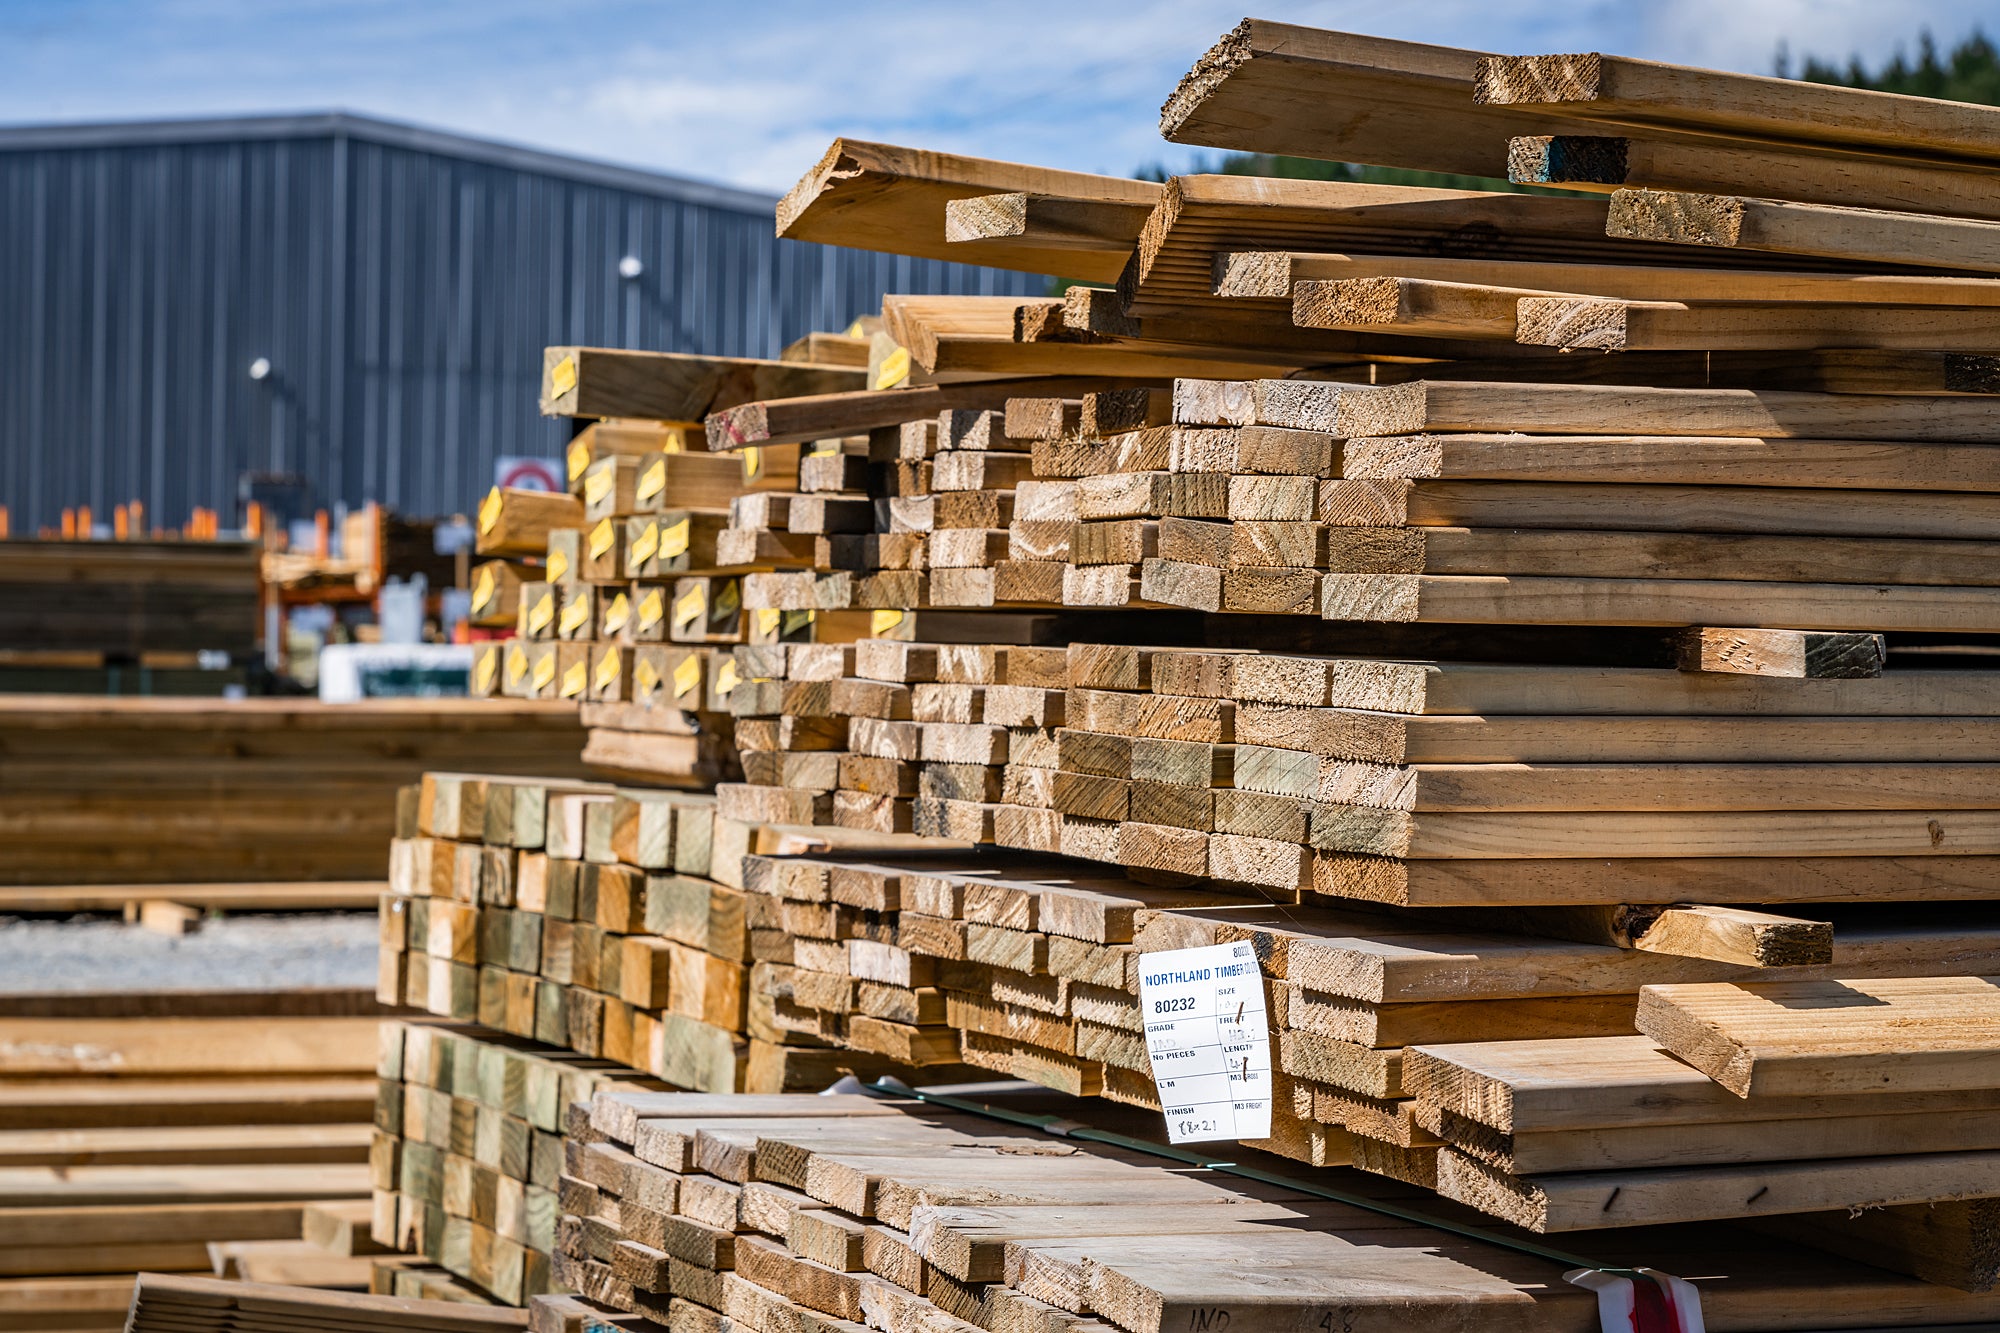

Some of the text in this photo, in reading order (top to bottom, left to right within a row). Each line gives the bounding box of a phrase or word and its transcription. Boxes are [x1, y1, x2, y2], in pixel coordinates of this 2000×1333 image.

[1145, 968, 1211, 987] NORTHLAND
[1214, 963, 1244, 979] TIMBER
[1218, 987, 1236, 996] SIZE
[1155, 997, 1196, 1014] 80232
[1147, 1023, 1176, 1033] GRADE
[1223, 1044, 1253, 1053] LENGTH
[1152, 1050, 1196, 1061] No PIECES
[1244, 1072, 1259, 1080] ROSS
[1166, 1107, 1195, 1116] FINISH
[1188, 1307, 1231, 1333] IND
